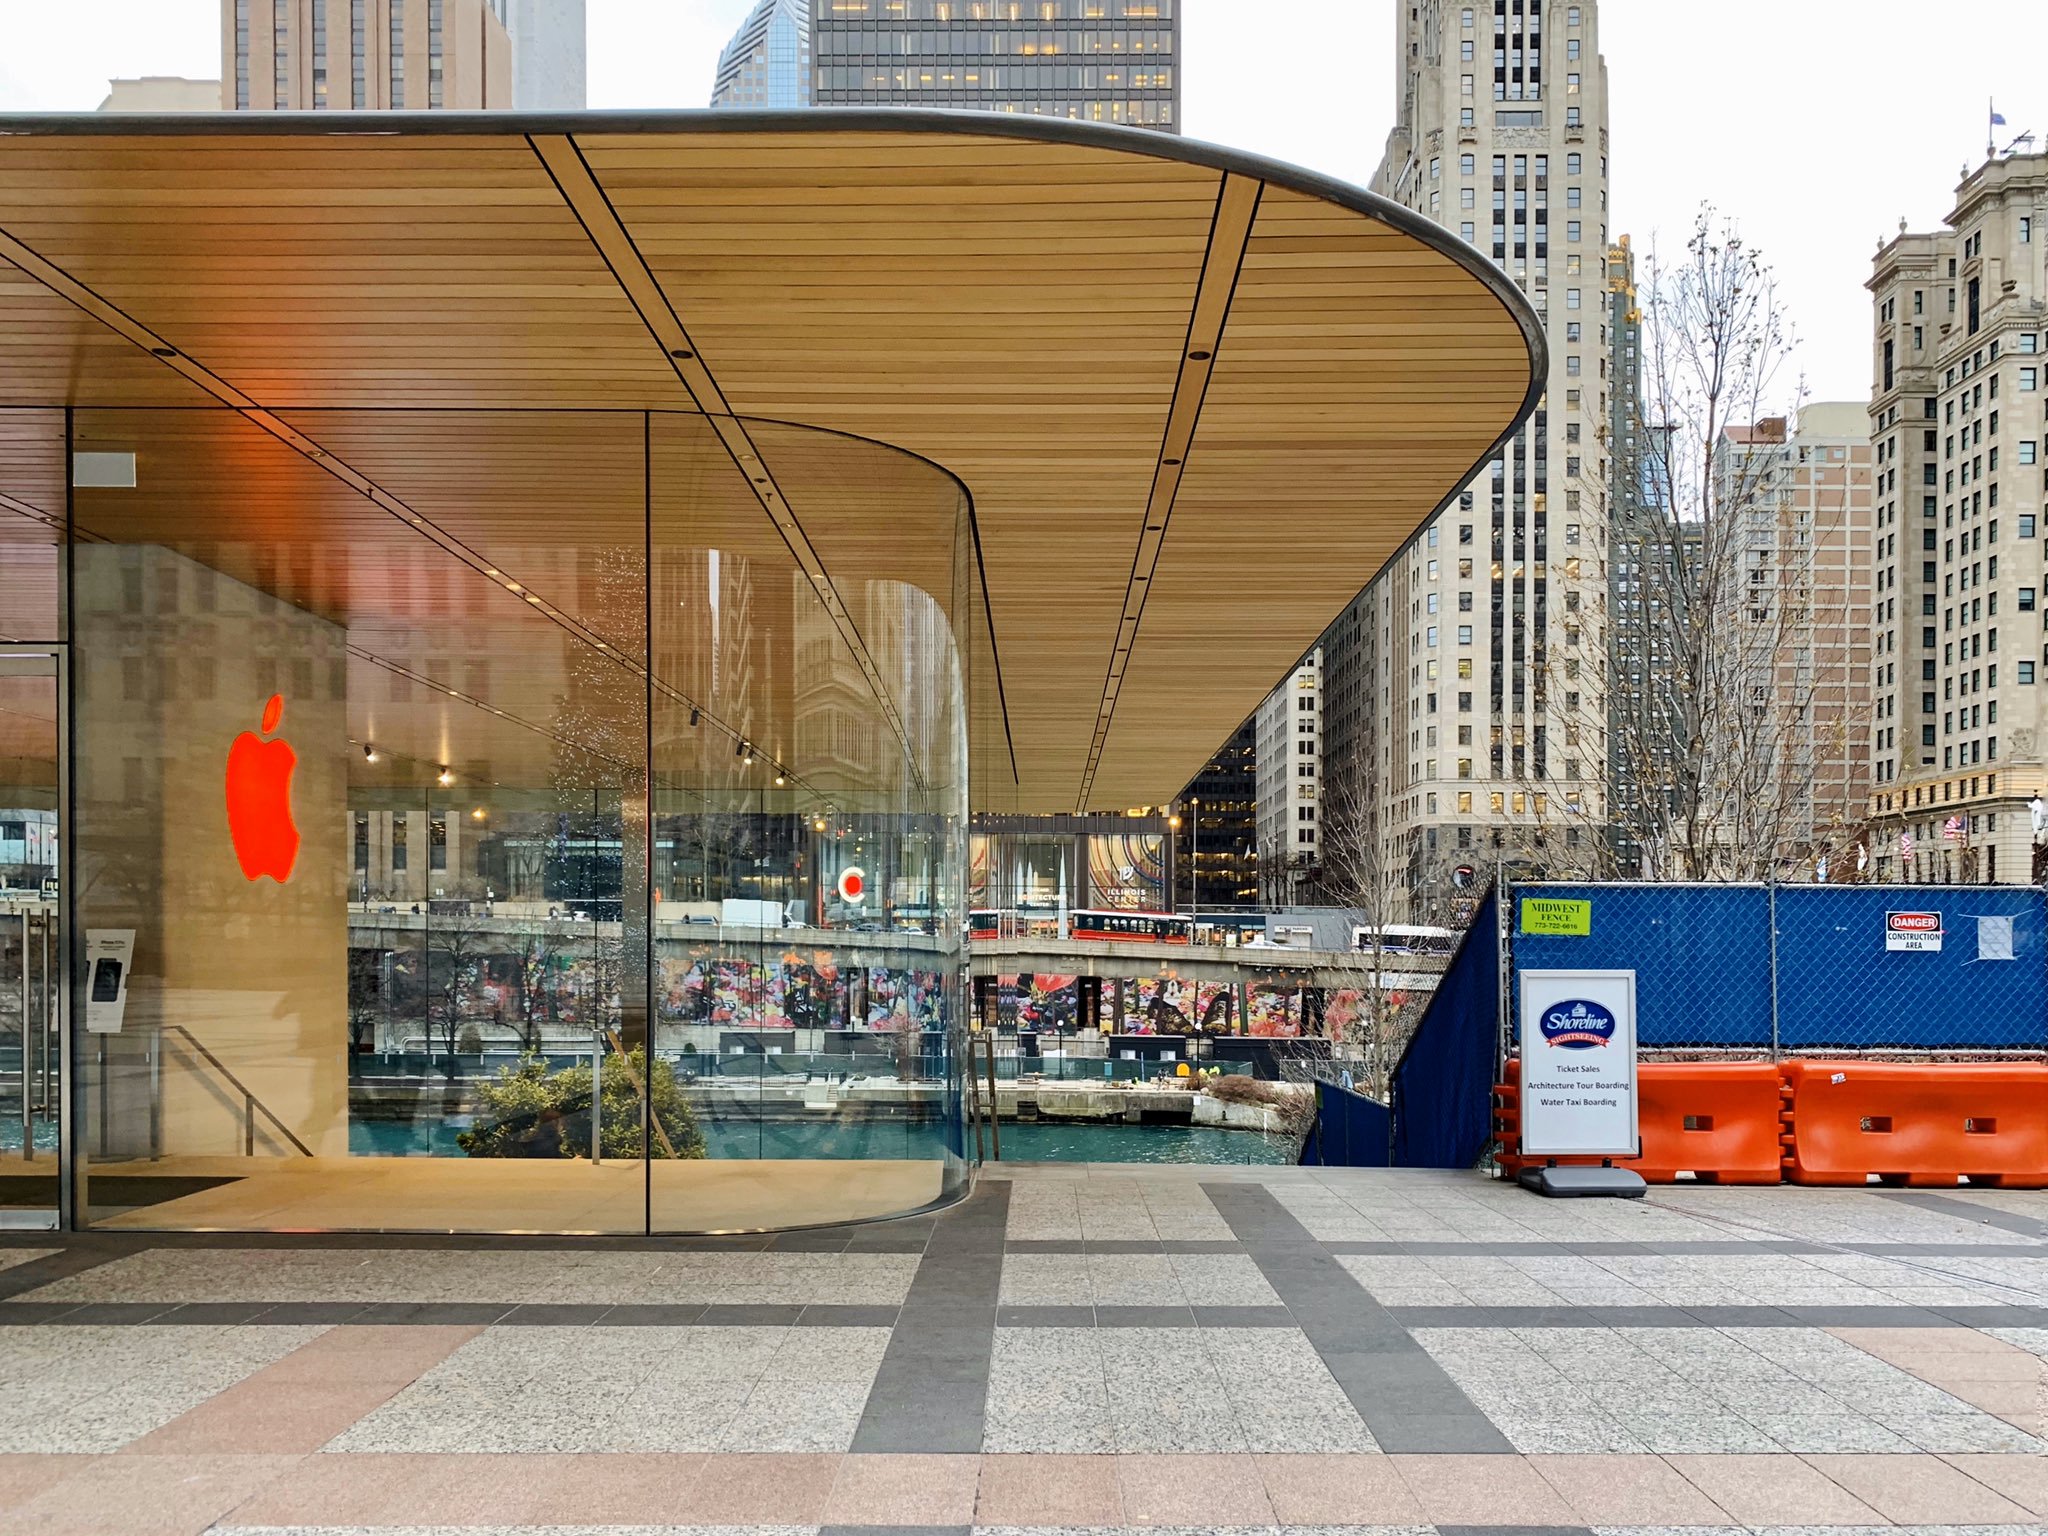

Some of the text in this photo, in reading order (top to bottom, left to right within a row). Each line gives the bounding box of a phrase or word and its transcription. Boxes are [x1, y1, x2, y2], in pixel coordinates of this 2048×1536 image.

[1532, 903, 1582, 913] MIDWEST
[1894, 918, 1935, 926] DANGER
[1546, 1013, 1608, 1030] Shoreline
[1550, 1032, 1605, 1045] SIGHTSEEING
[1556, 1065, 1600, 1073] Ticket Sales
[1528, 1082, 1630, 1091] Architecture Tour Boarding
[1540, 1098, 1617, 1107] Water Taxi Boarding
